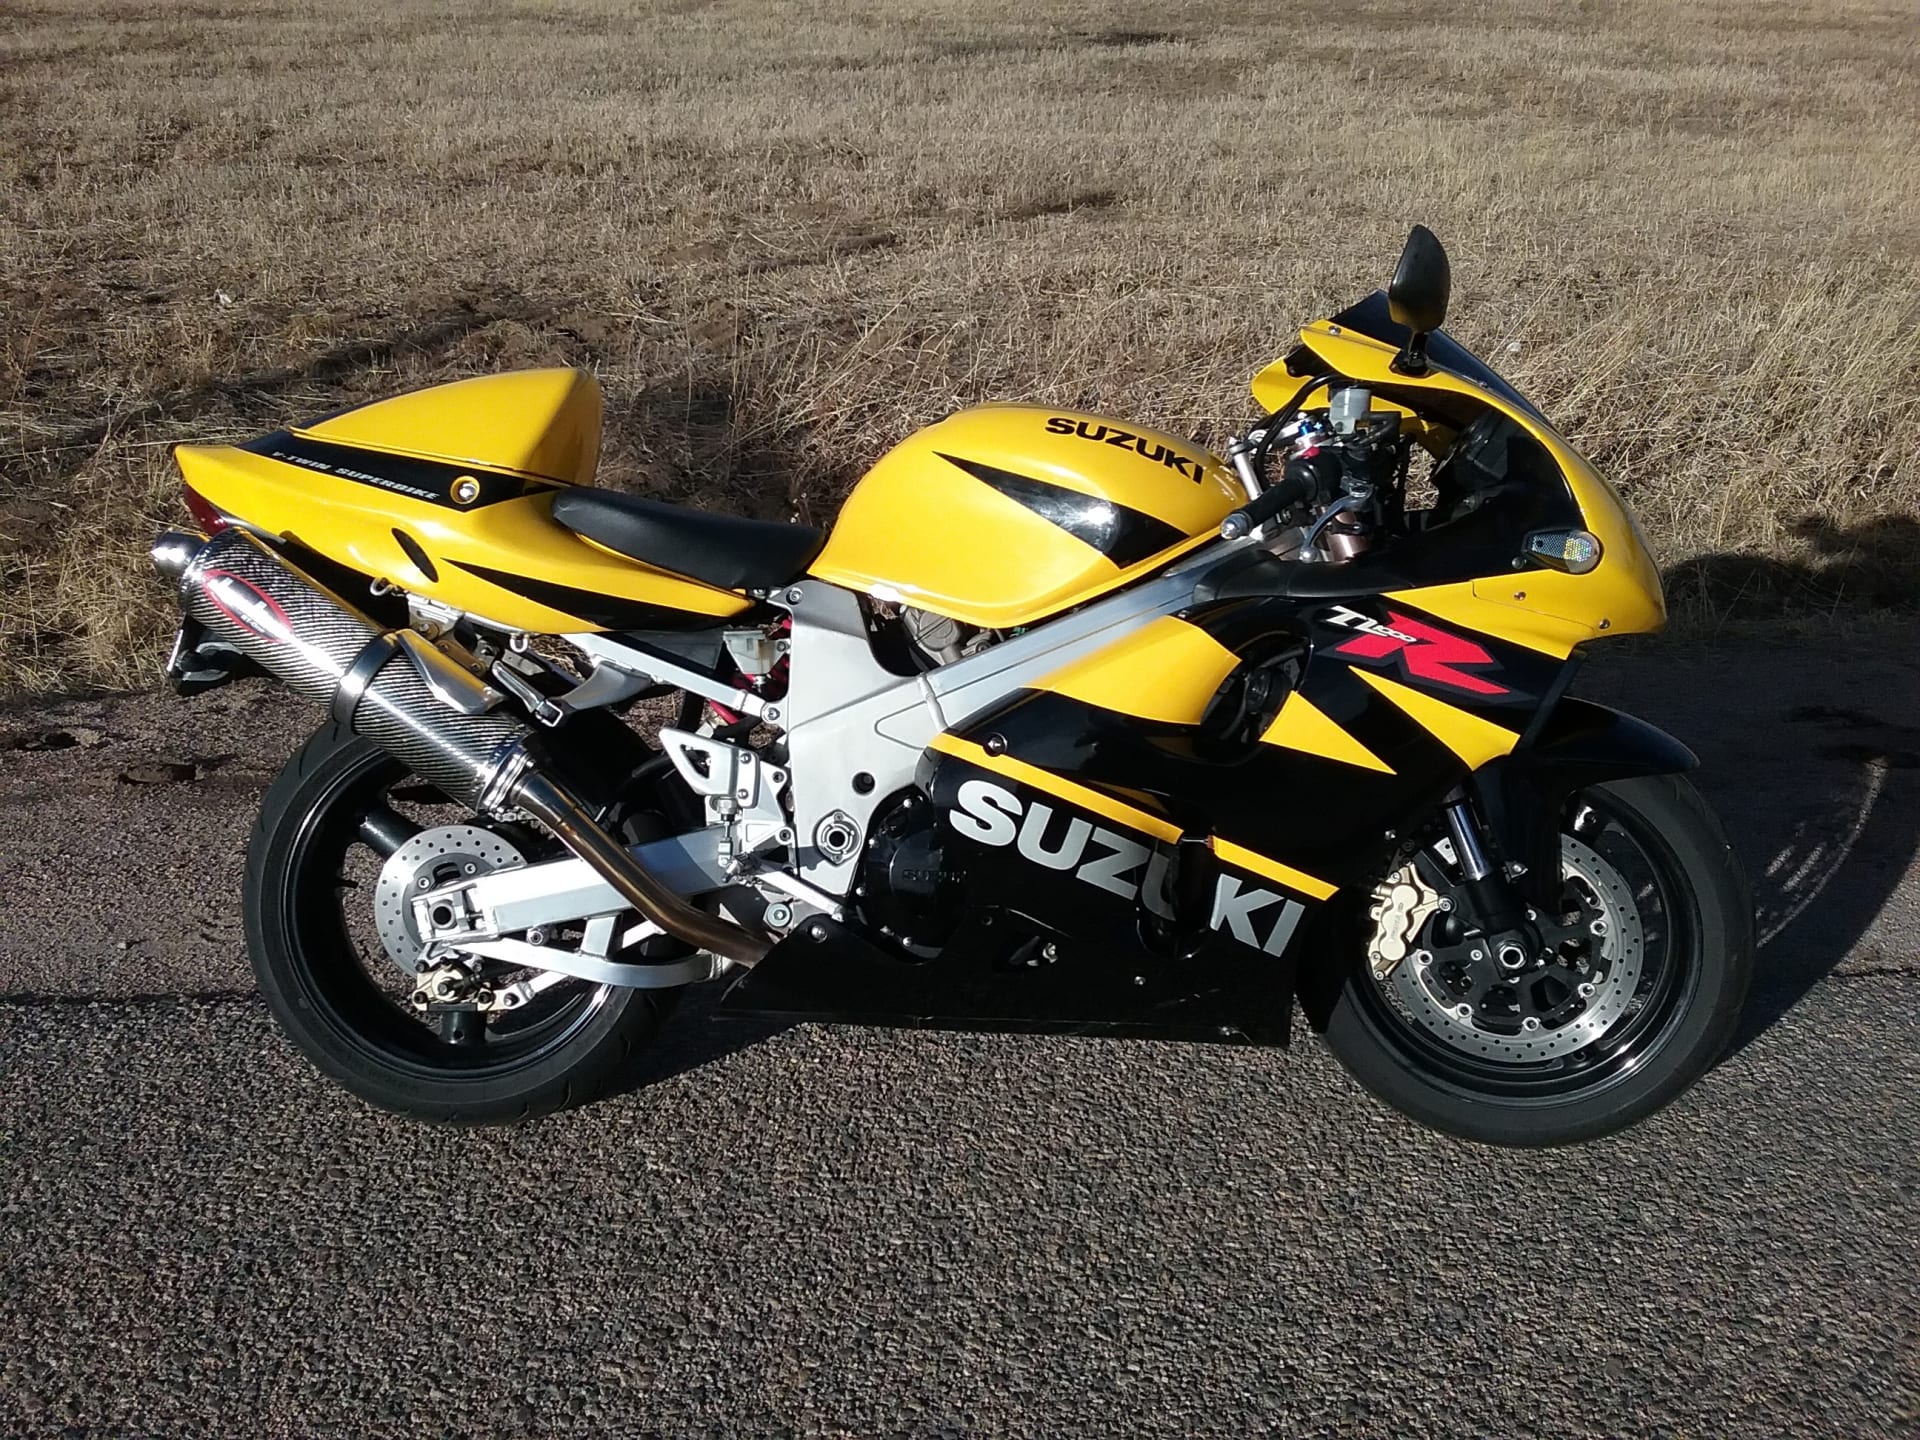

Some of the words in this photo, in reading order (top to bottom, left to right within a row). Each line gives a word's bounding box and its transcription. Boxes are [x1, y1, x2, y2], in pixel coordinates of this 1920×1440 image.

[272, 451, 332, 470] V-TWIN
[335, 467, 440, 500] SUPERBIKE
[1045, 417, 1204, 485] SUZUKI
